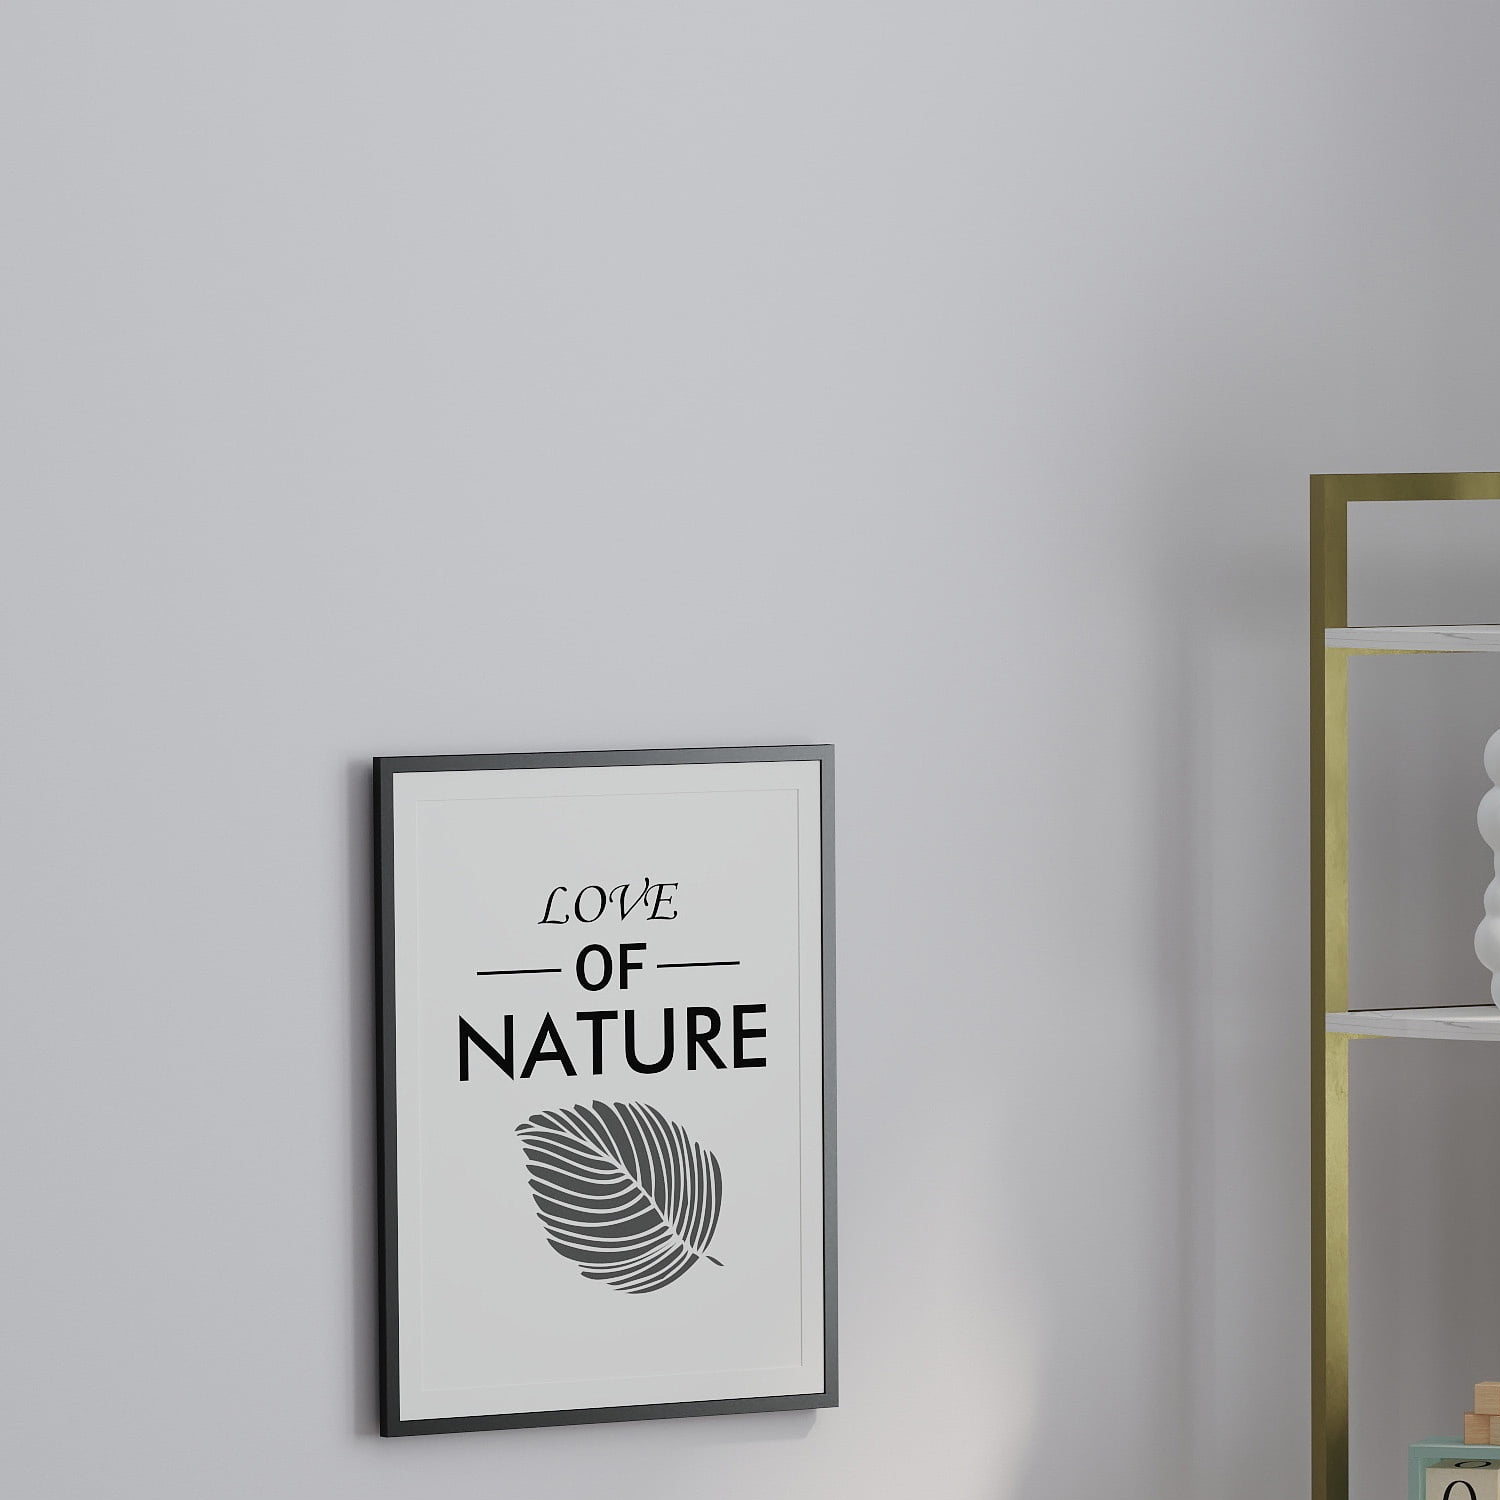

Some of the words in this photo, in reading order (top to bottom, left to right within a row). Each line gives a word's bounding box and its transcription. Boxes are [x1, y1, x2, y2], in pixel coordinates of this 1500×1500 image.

[537, 877, 679, 926] LOVE
[575, 942, 648, 992] OF
[457, 1003, 768, 1083] NATURE
